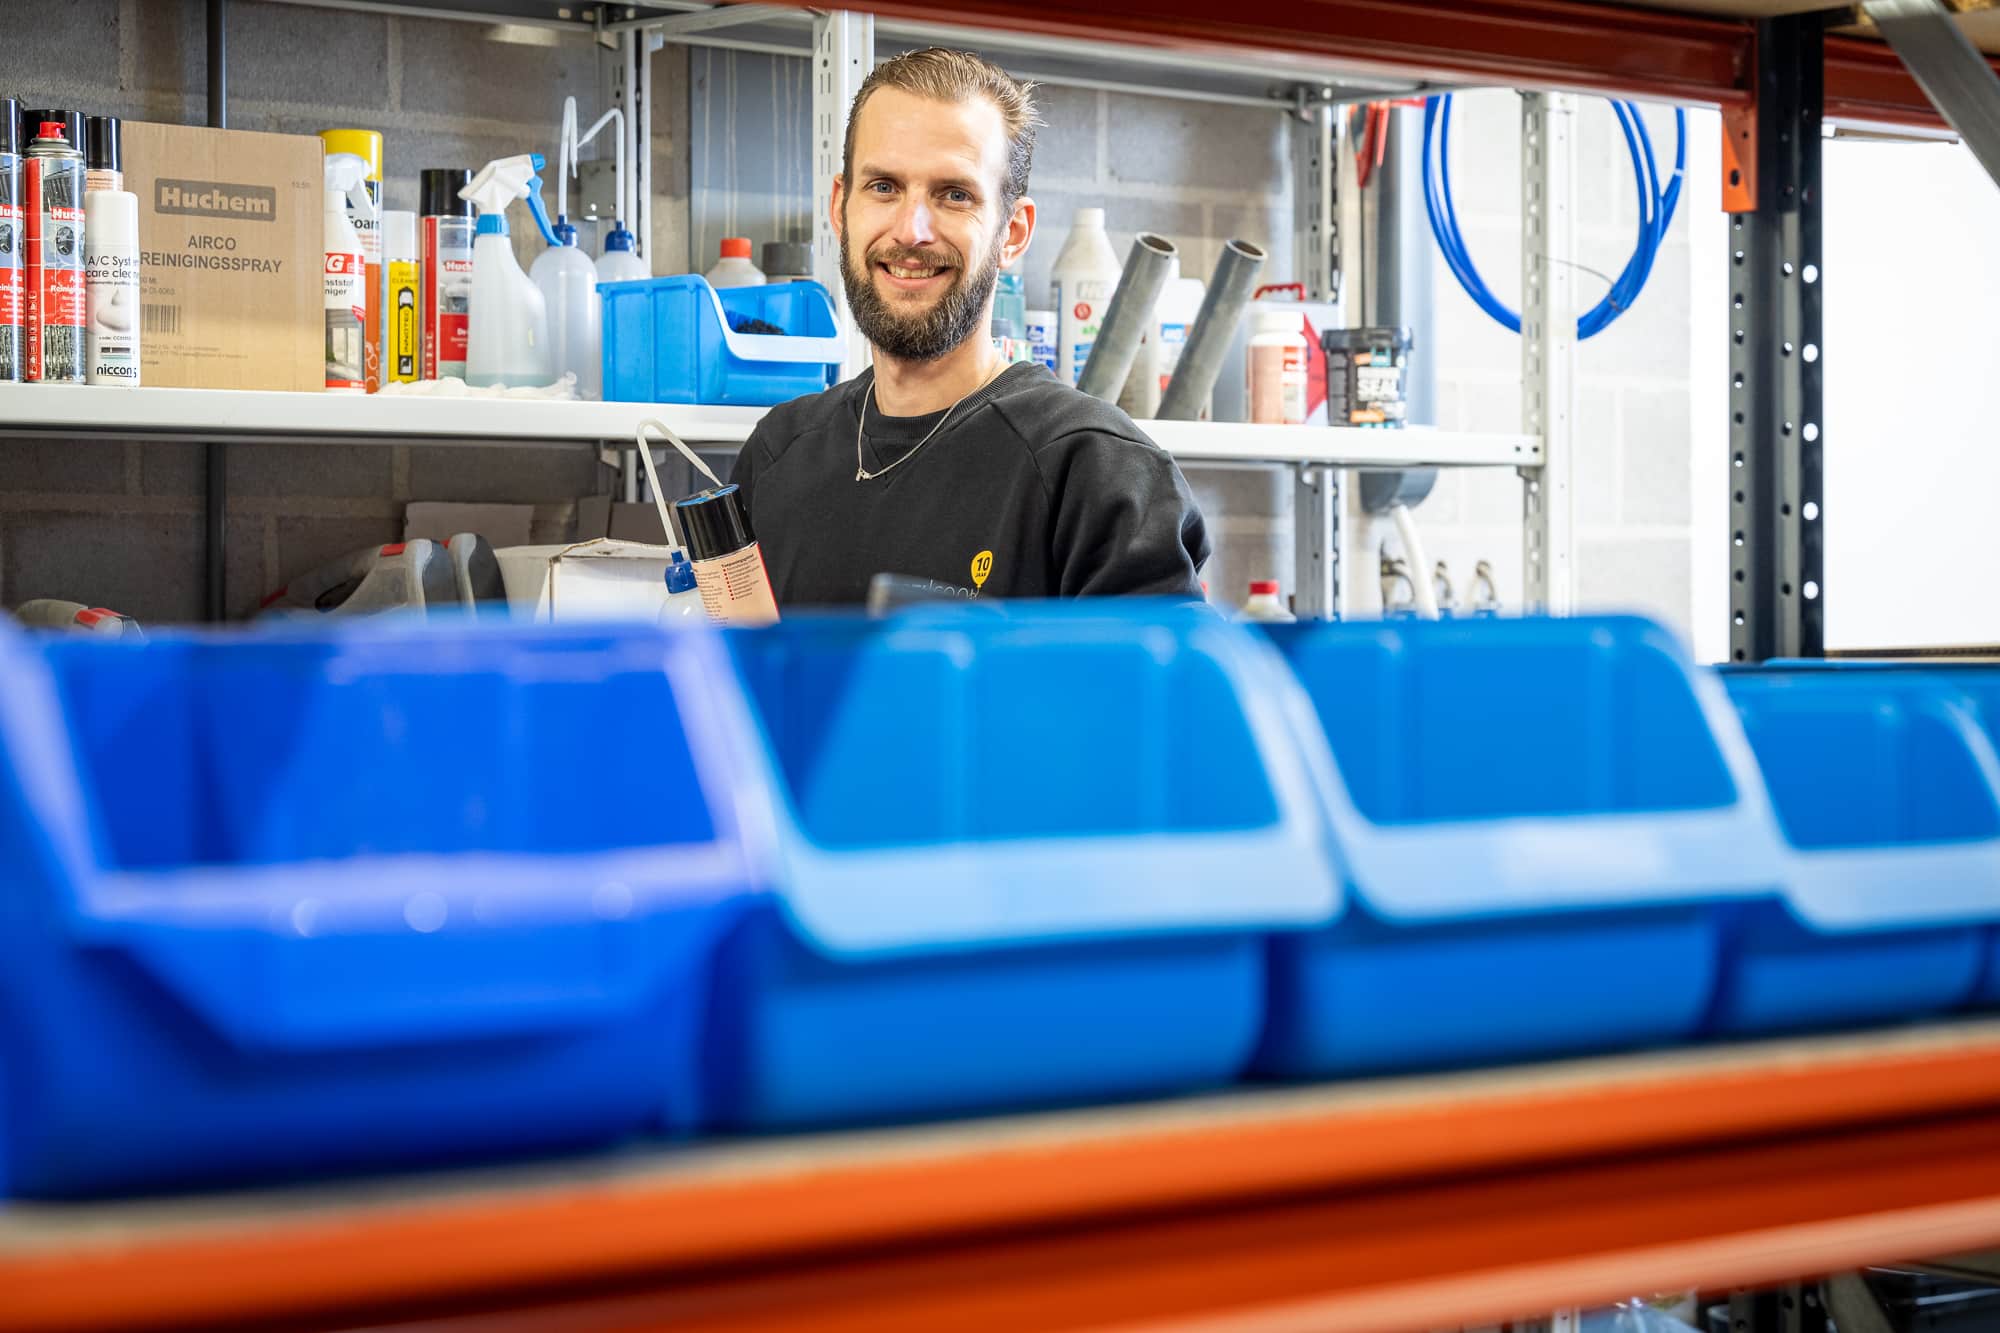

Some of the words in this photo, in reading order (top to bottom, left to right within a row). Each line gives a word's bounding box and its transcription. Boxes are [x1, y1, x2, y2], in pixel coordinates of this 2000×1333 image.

[160, 186, 271, 214] Huchem
[188, 235, 237, 251] AIRCO
[88, 255, 109, 266] A/C
[140, 251, 282, 273] REINIGINGSSPRAY
[85, 270, 109, 278] care
[977, 557, 990, 571] 10
